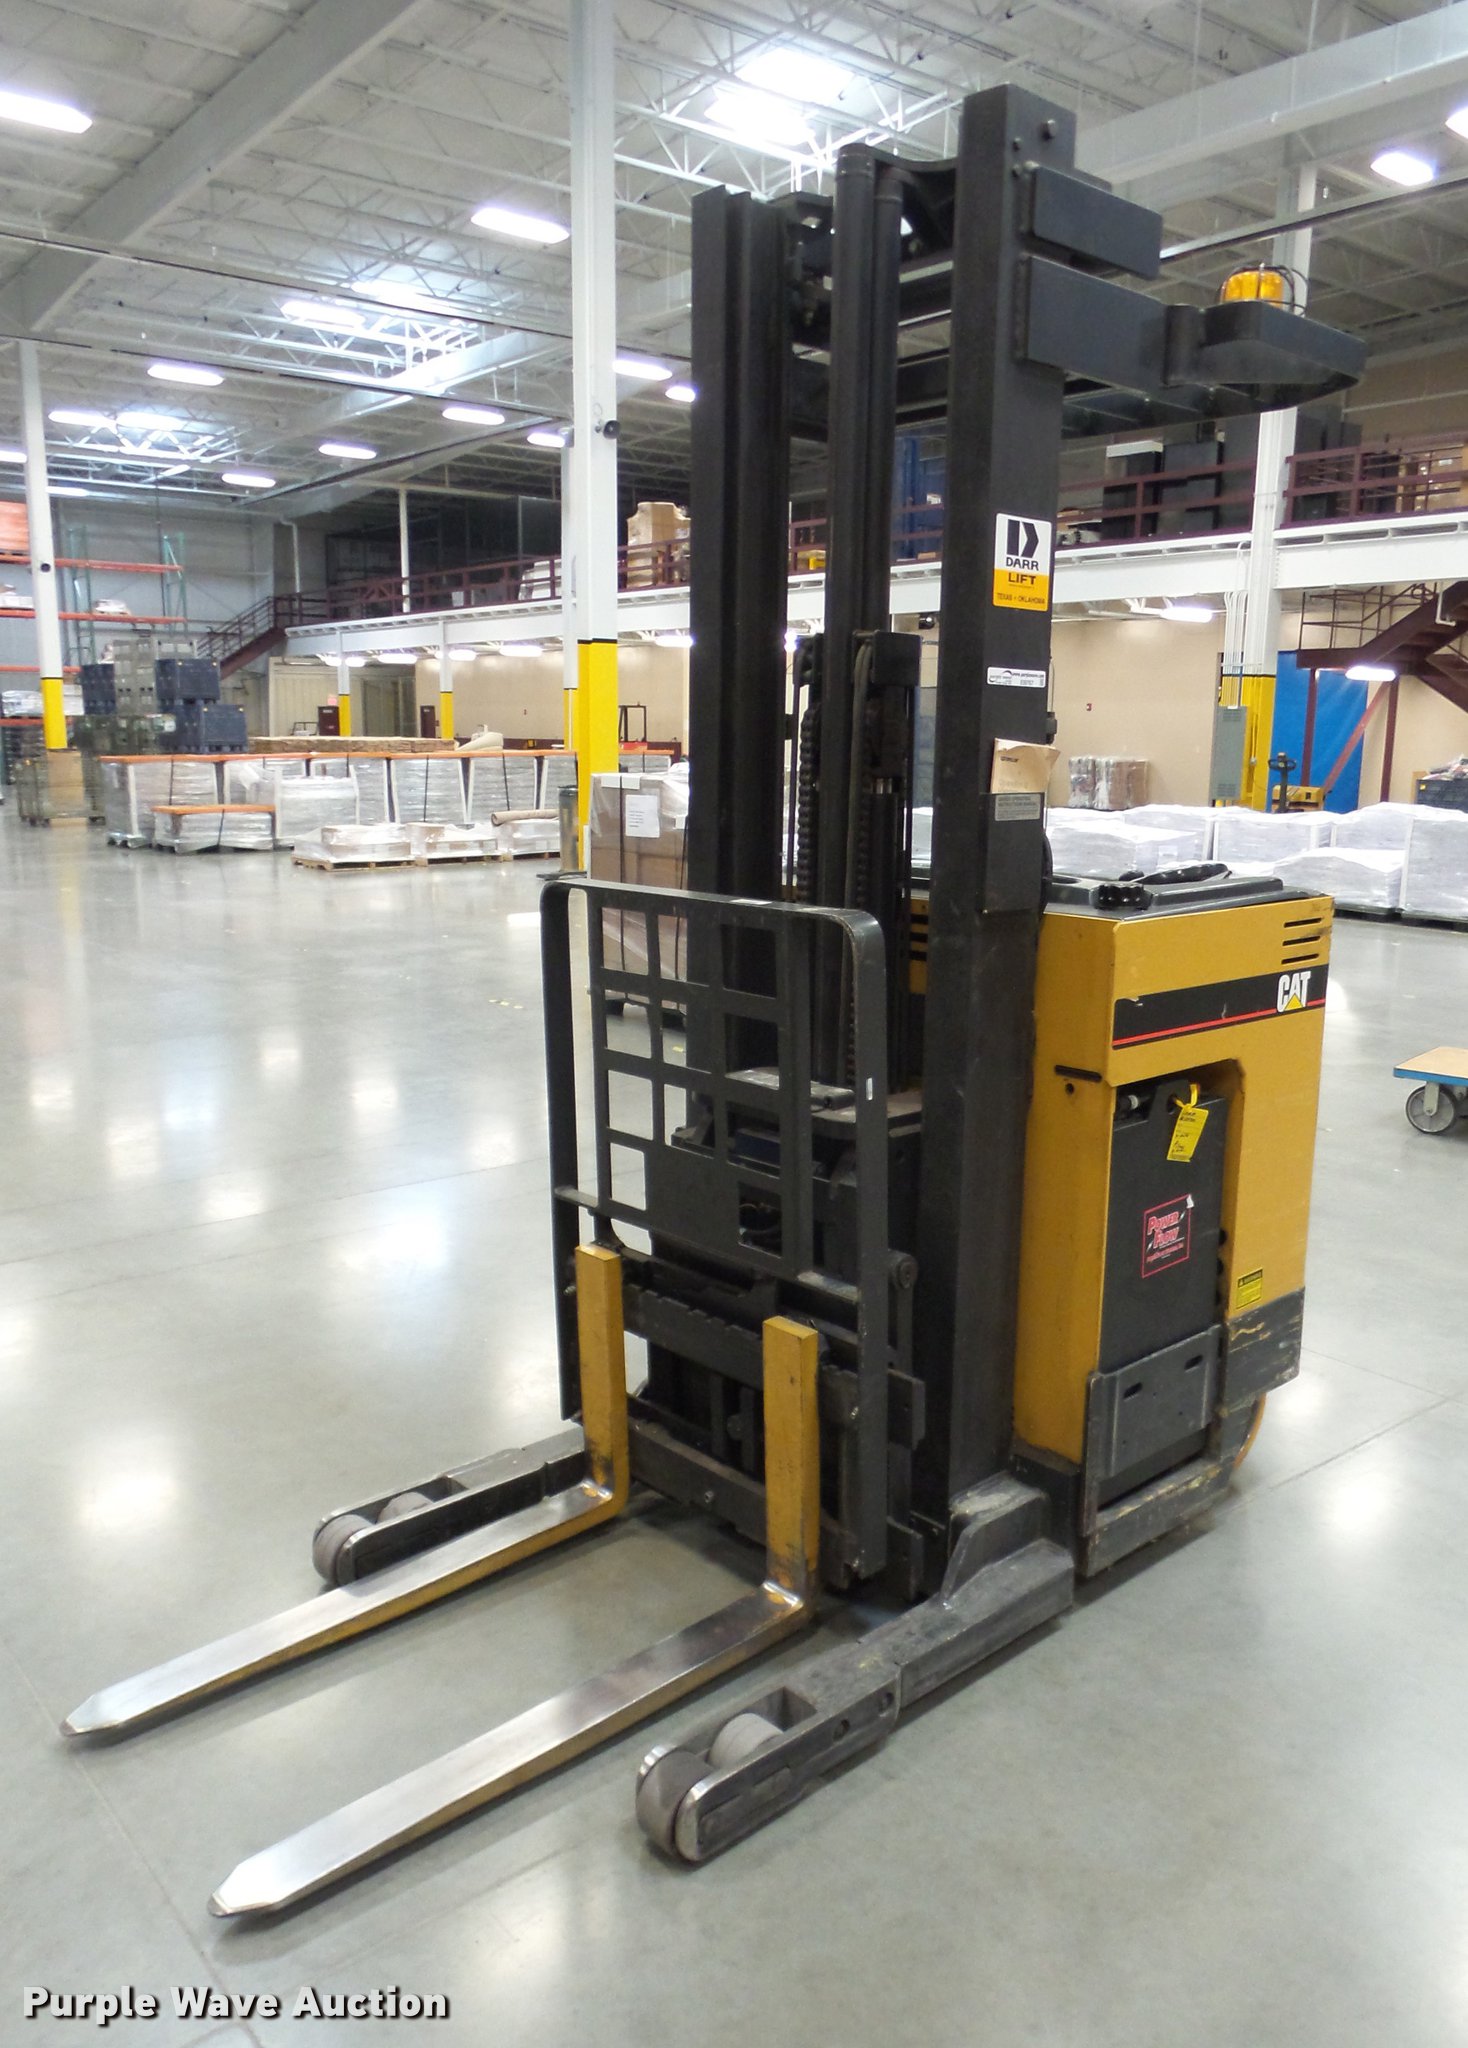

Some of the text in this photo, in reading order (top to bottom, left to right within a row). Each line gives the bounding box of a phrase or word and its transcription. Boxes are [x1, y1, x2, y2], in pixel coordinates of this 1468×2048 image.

[1006, 556, 1039, 571] DARR
[1008, 572, 1036, 585] LIFT
[1276, 971, 1312, 1013] CAT
